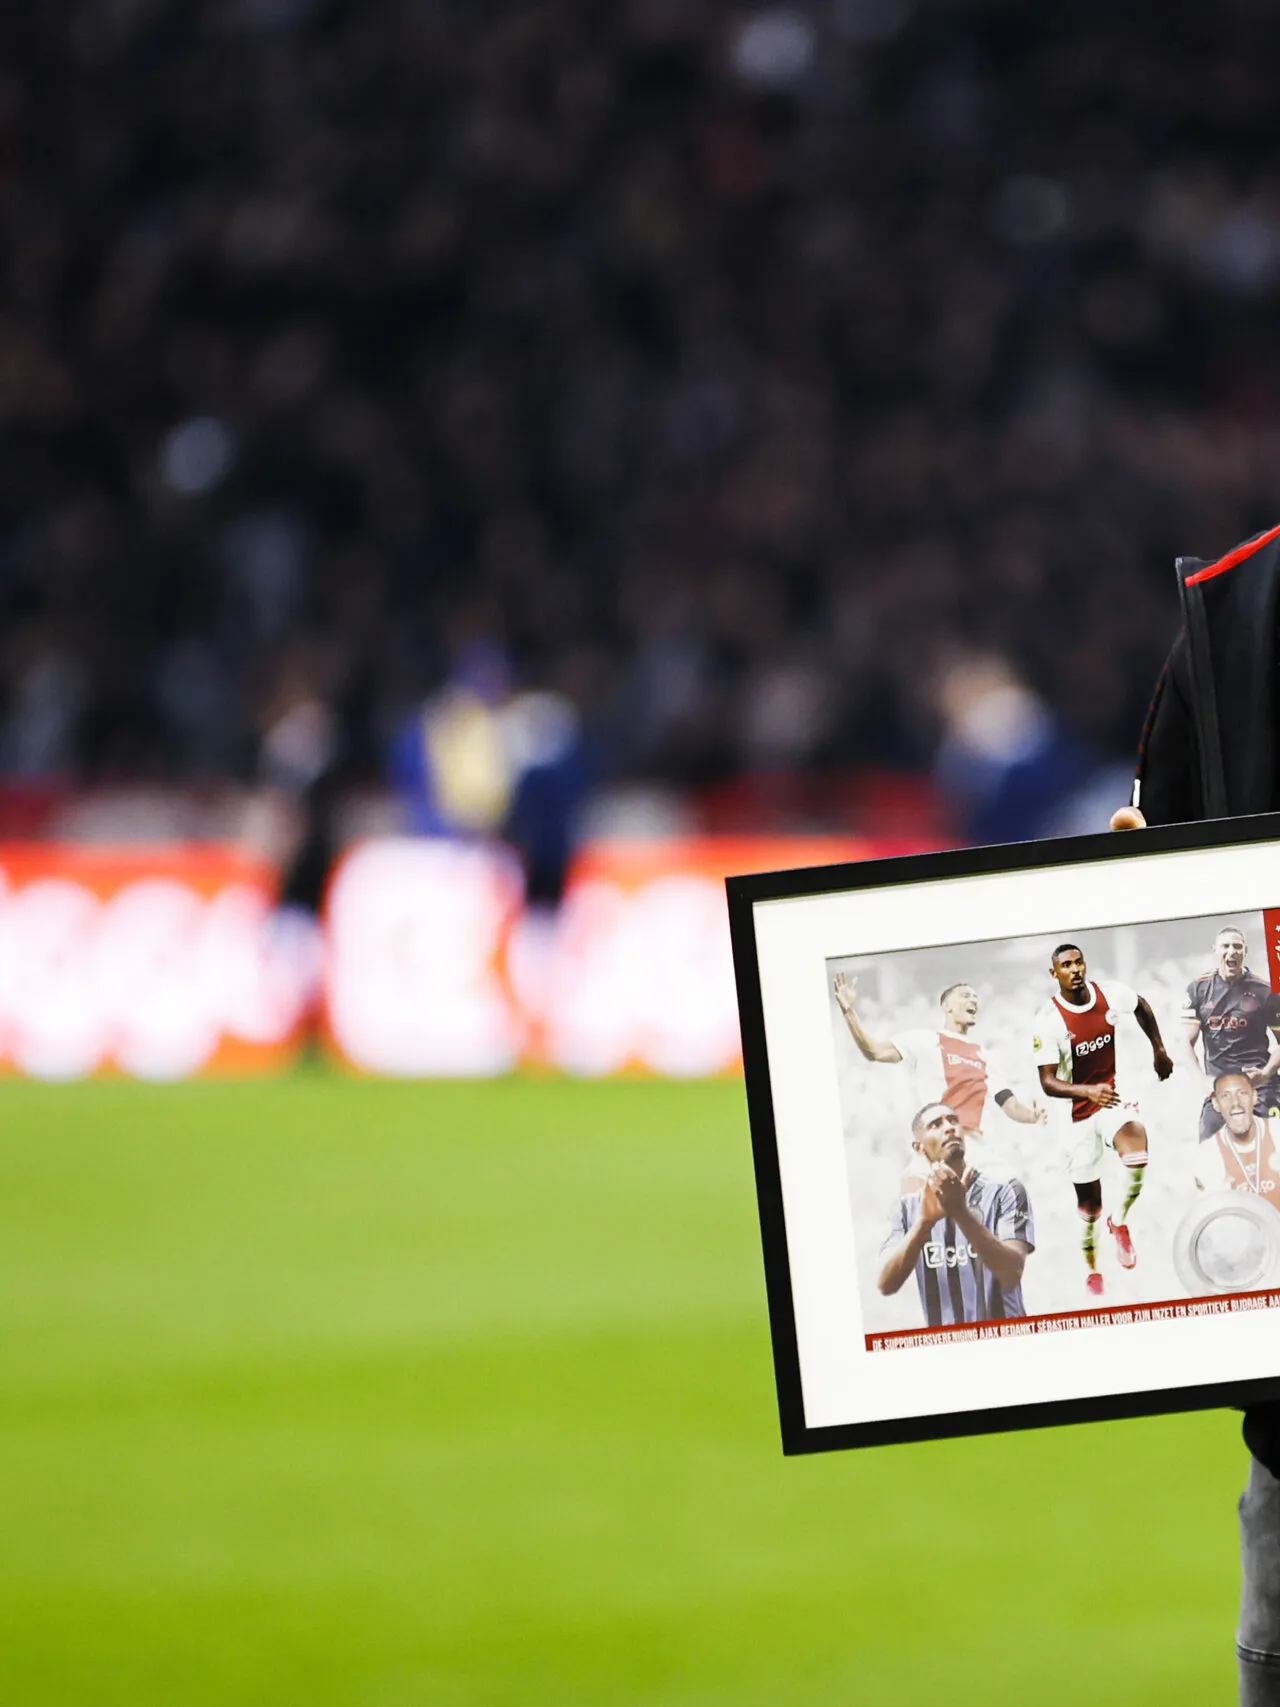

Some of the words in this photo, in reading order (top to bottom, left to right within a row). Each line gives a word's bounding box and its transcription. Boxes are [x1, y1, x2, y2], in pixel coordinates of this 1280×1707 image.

[872, 1339, 883, 1351] DE
[884, 1330, 978, 1350] SUPPORTERSVERENIGING
[979, 1326, 999, 1340] AJAX
[1000, 1322, 1037, 1338] BEDANKT
[1037, 1317, 1080, 1334] SÉBASTIEN
[1081, 1313, 1111, 1329] HALLER
[1111, 1310, 1133, 1325] VOOR
[1134, 1309, 1151, 1323] ZIJN
[1151, 1306, 1175, 1321] INZET
[1175, 1304, 1187, 1319] EN
[1187, 1300, 1230, 1317] SPORTIEVE
[1231, 1295, 1268, 1312] BIJDRAGE
